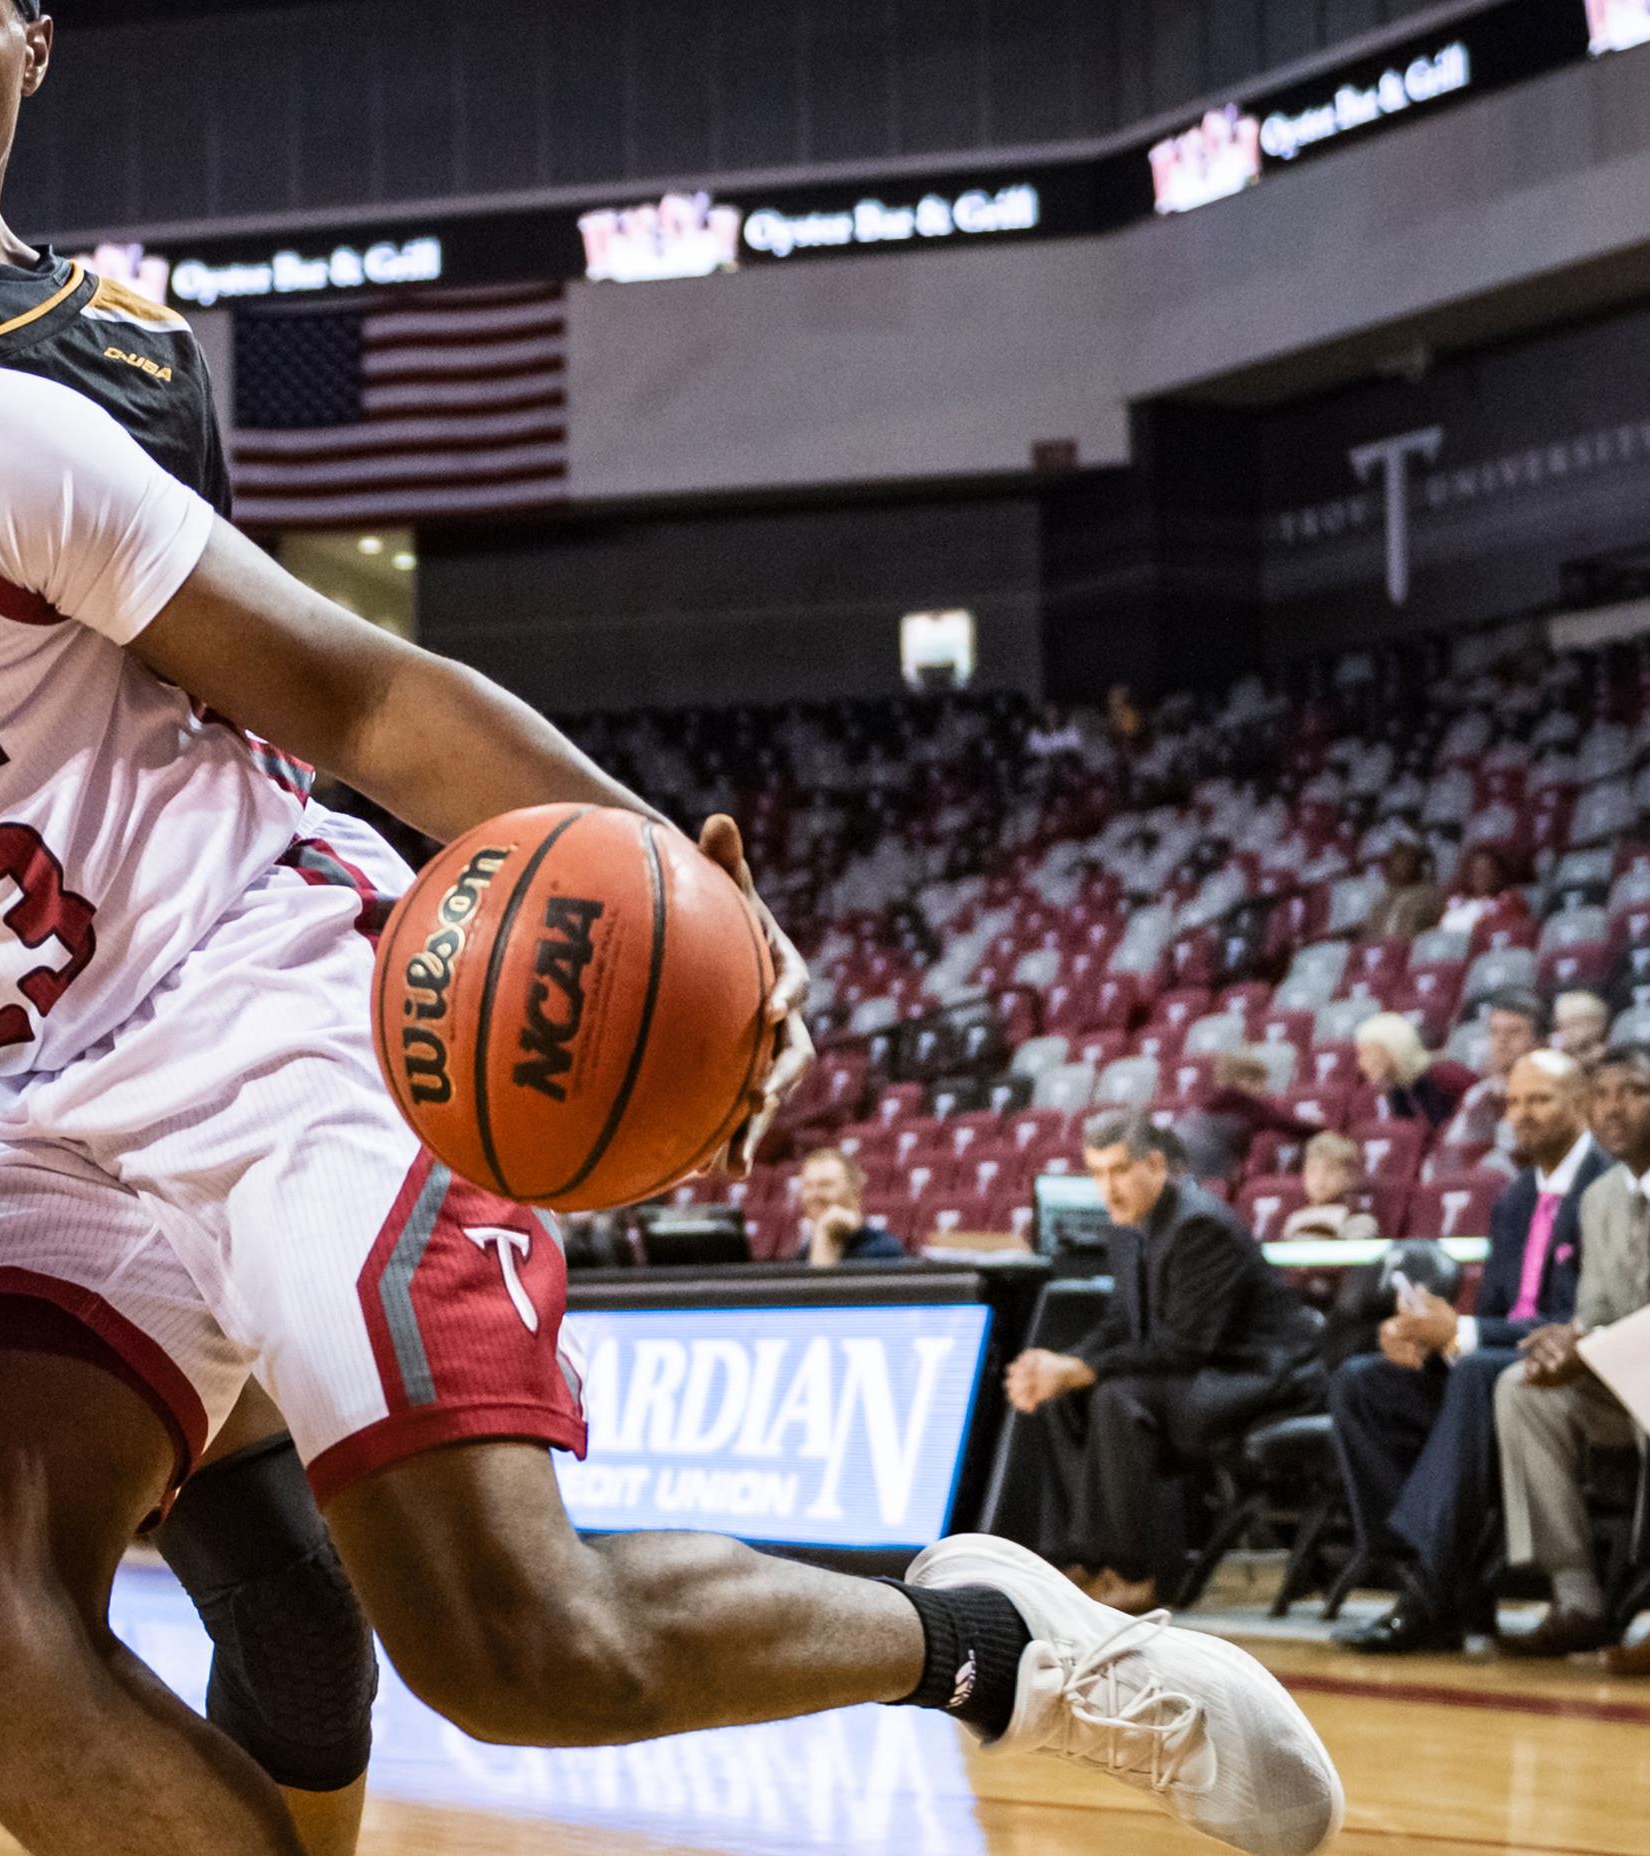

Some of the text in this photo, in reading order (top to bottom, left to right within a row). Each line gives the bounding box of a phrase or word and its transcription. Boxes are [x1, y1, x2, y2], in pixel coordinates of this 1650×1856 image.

[402, 846, 518, 1106] Wilson
[513, 895, 604, 1103] NCAA
[458, 1223, 540, 1338] T
[654, 1467, 798, 1518] UNION
